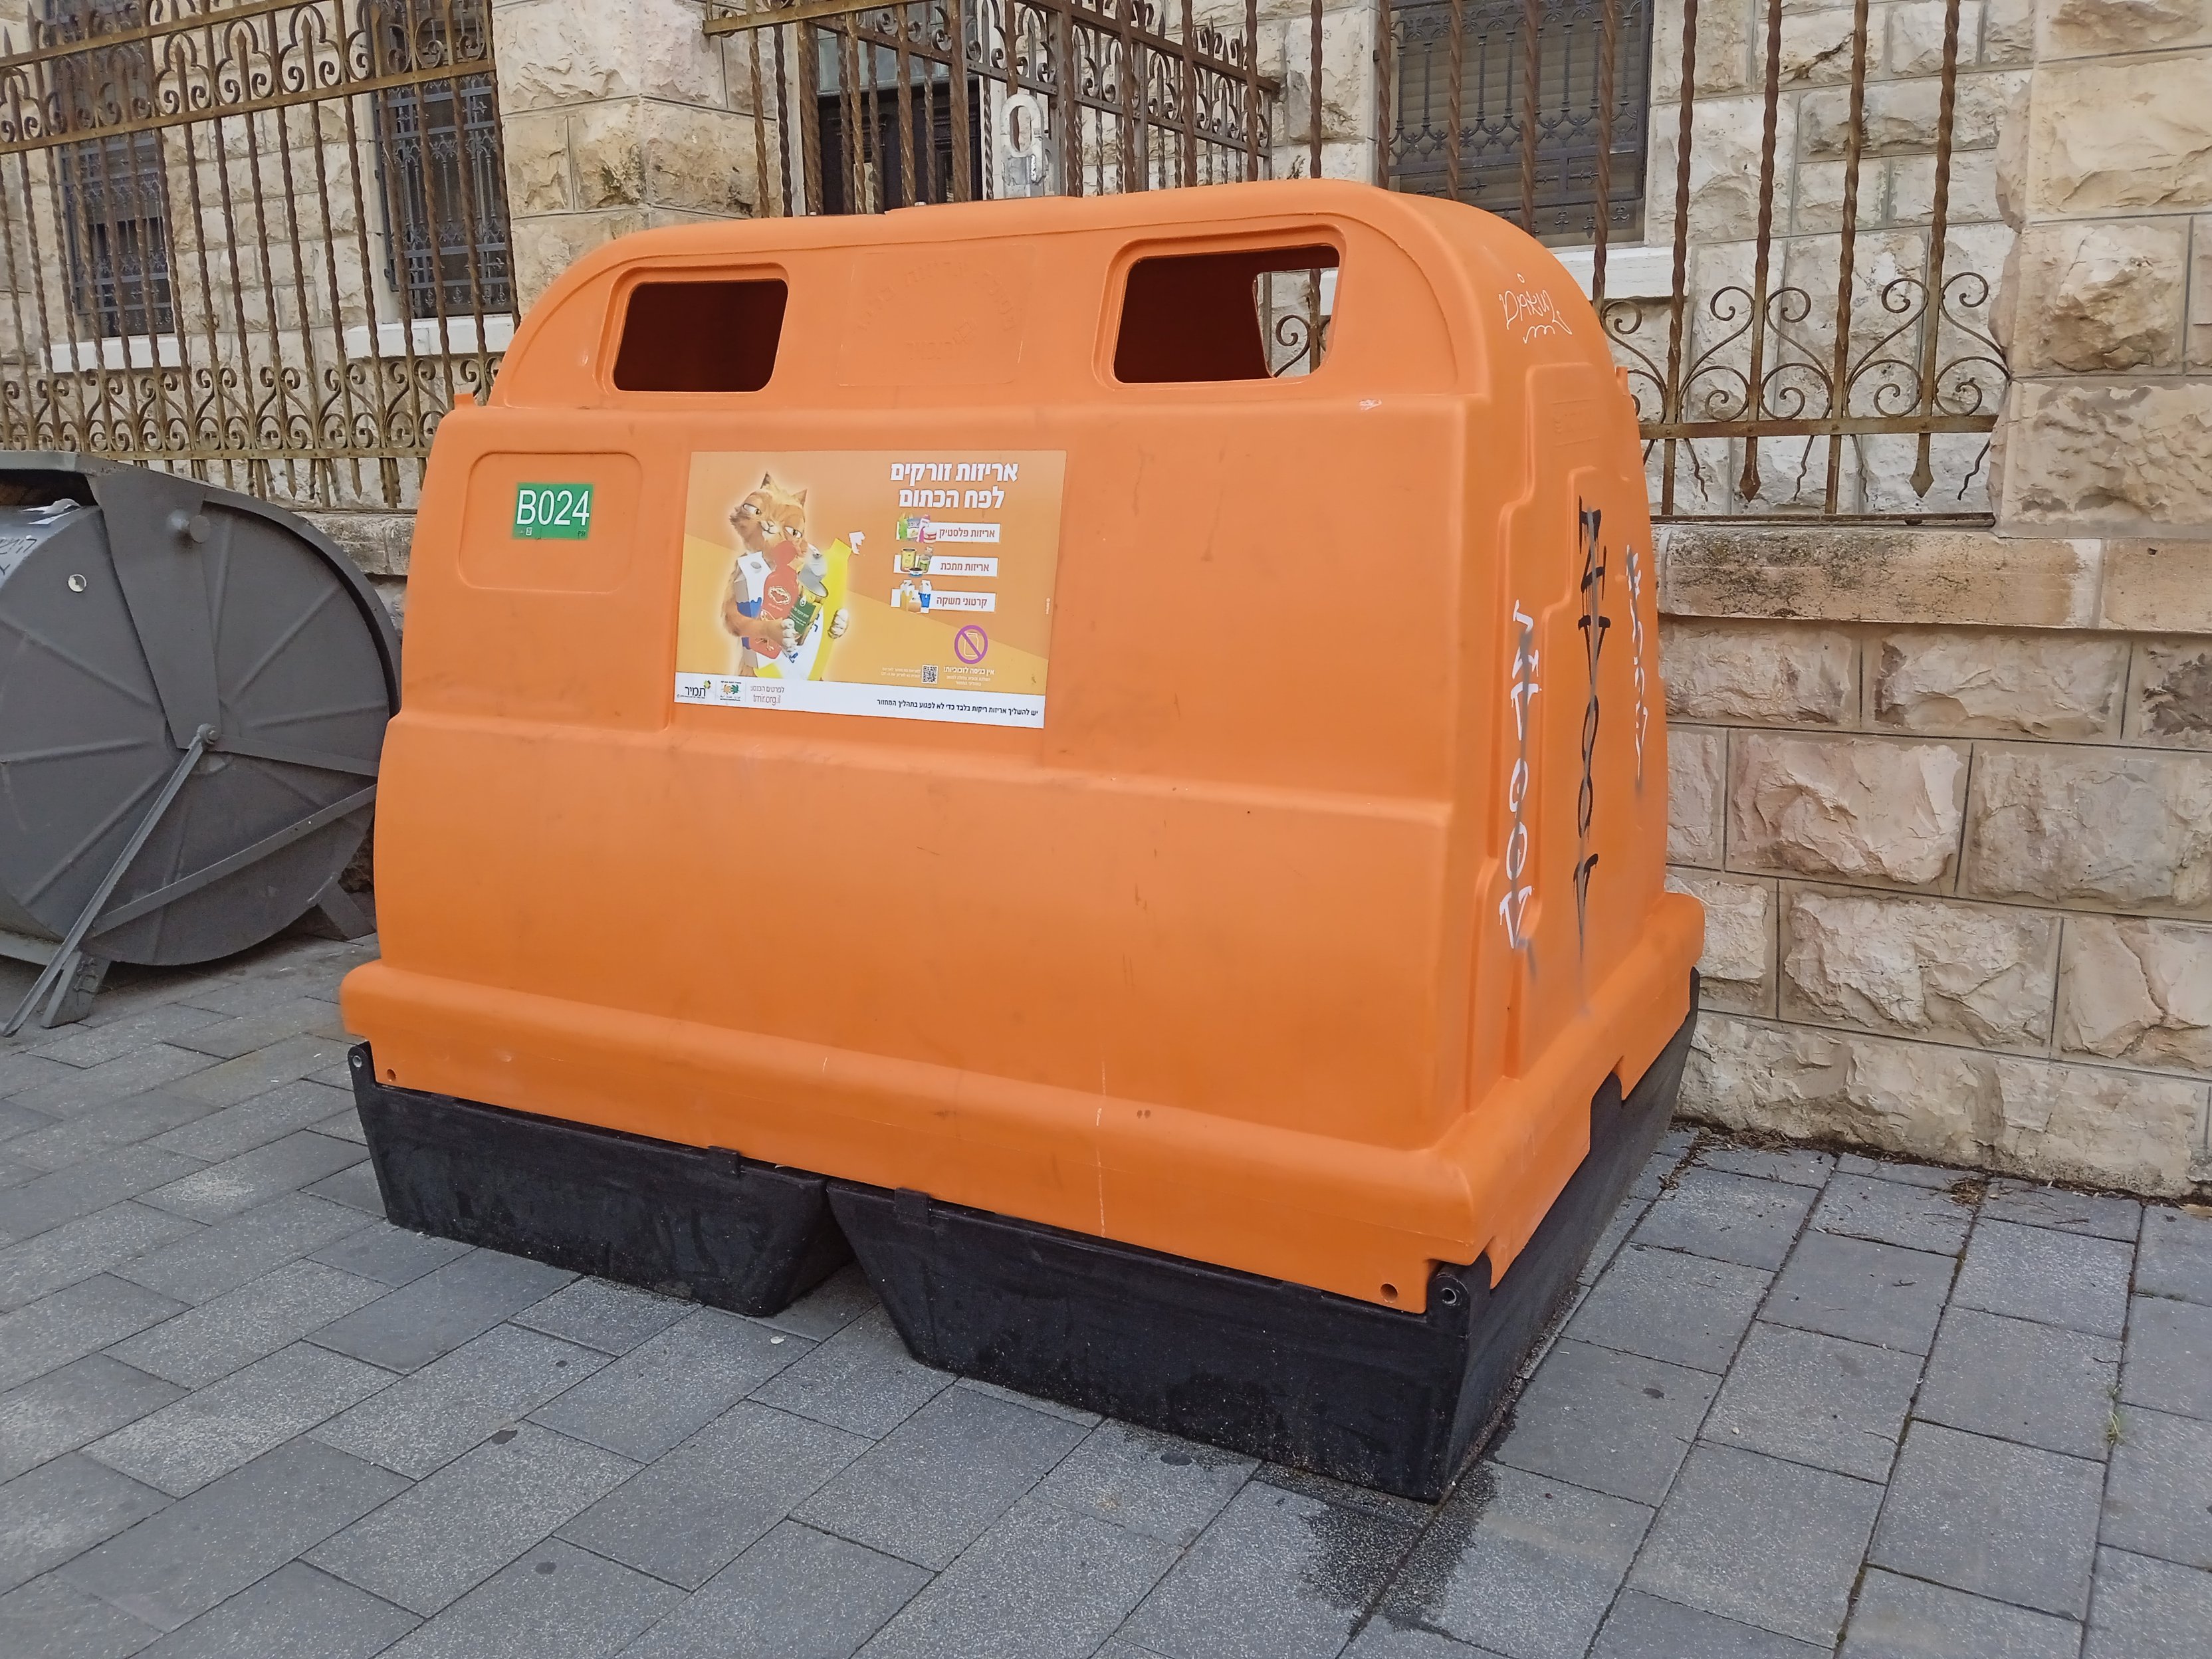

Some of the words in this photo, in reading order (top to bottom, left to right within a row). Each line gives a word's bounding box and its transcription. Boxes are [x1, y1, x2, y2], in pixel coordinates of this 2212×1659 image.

[890, 463, 952, 487] זורקים
[955, 463, 1018, 482] אריזות
[899, 489, 960, 508] הכתום
[964, 486, 1004, 508] לפח
[516, 489, 590, 526] B024
[939, 528, 968, 538] פלסטיק
[970, 529, 995, 538] אריזות
[964, 563, 989, 572] אריזות
[937, 597, 960, 607] משקה
[963, 598, 987, 608] קרטוני
[685, 687, 706, 697] תמיר
[753, 693, 781, 706] tmir.org.il
[898, 700, 918, 709] בתהליך
[919, 701, 935, 710] לפגוע
[972, 705, 988, 714] ריקות
[1008, 708, 1030, 717] להשליך
